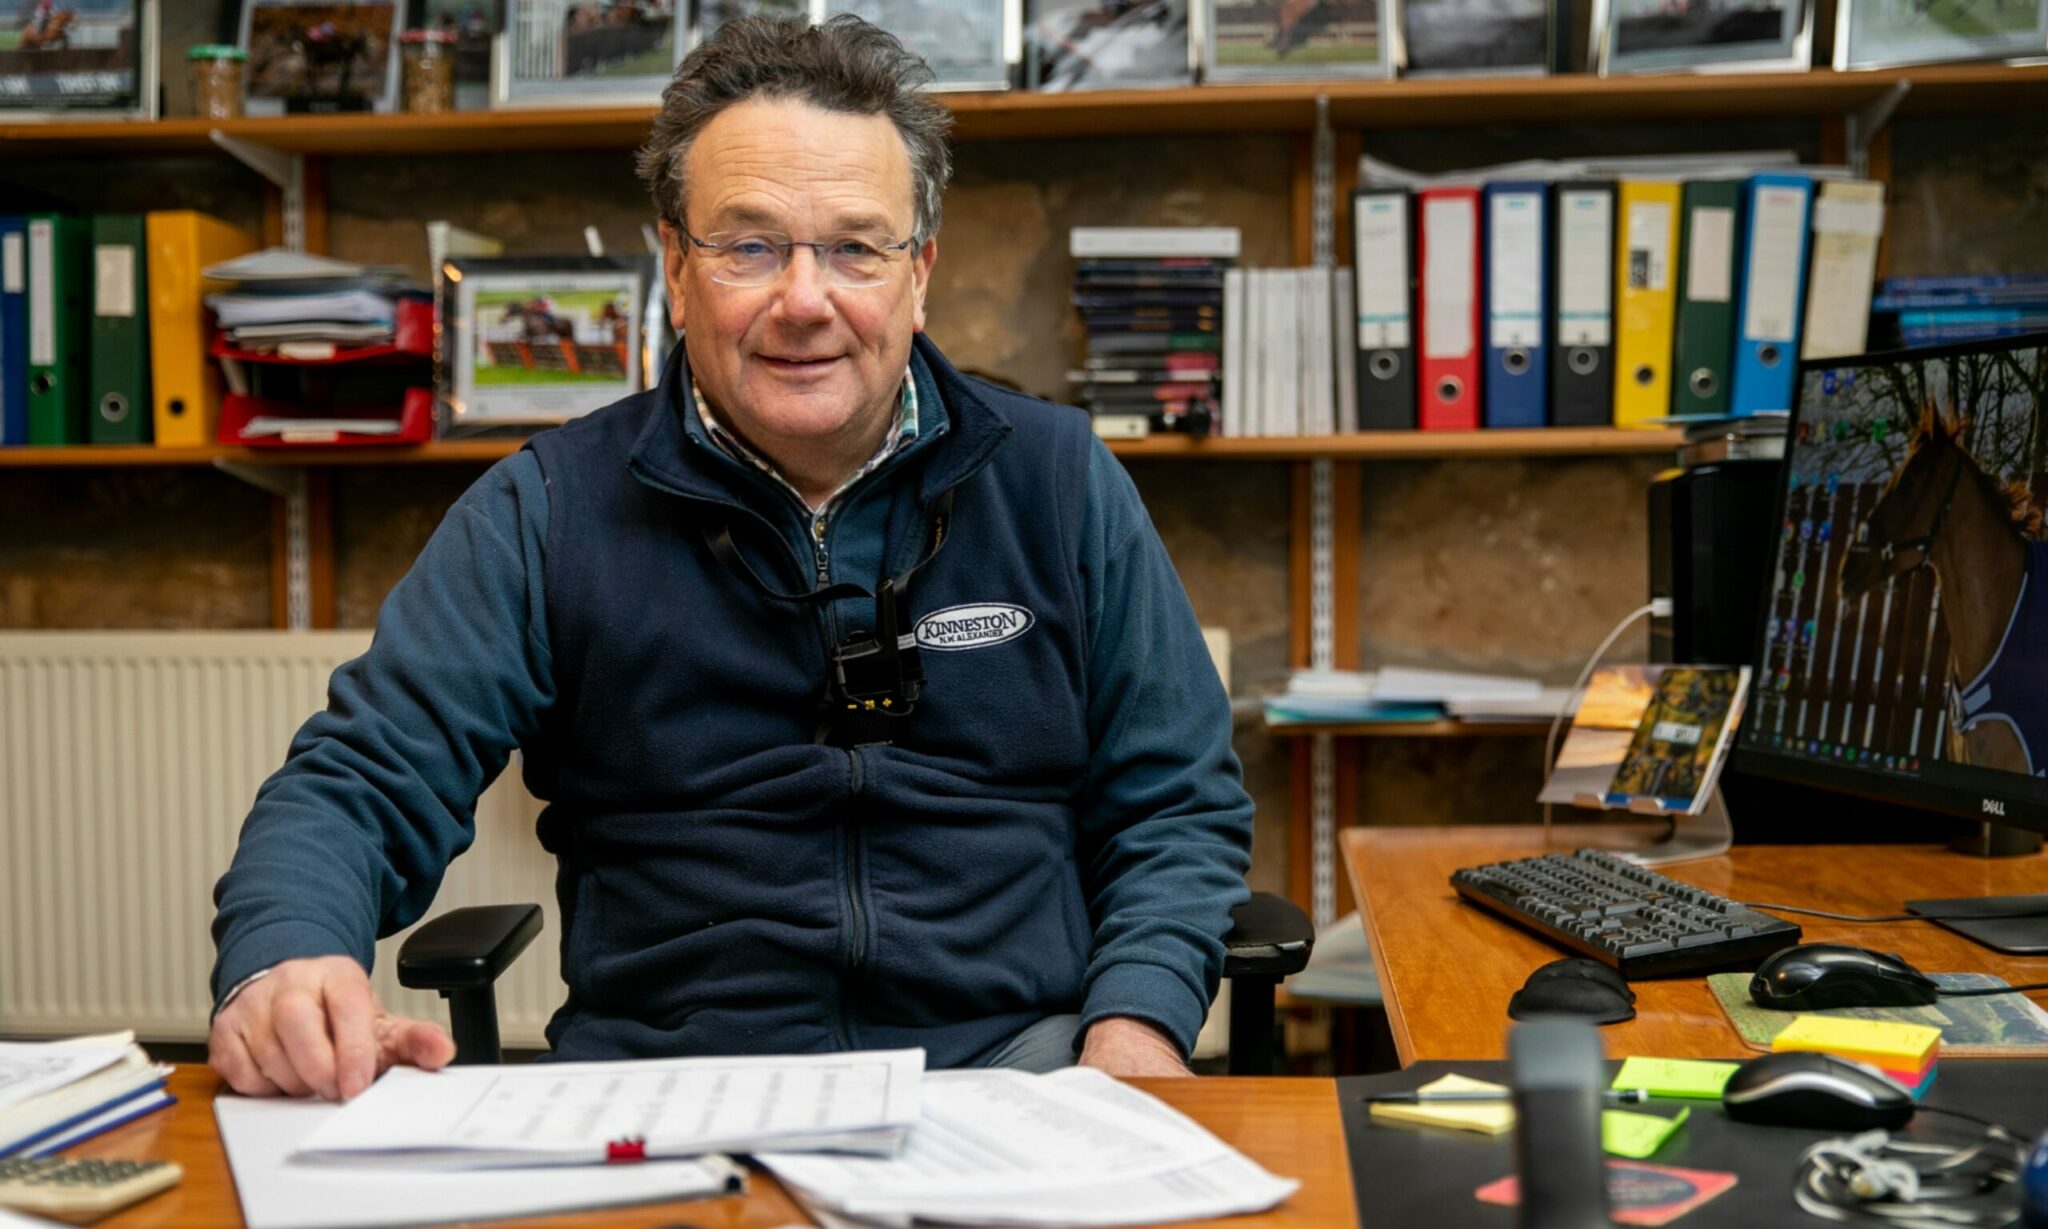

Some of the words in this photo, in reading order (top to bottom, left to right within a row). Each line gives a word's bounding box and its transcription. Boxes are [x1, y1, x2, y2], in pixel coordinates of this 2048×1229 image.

[923, 610, 1017, 639] KINNESTON
[957, 628, 1004, 642] ALEXANDER
[1982, 798, 2006, 816] DELL
